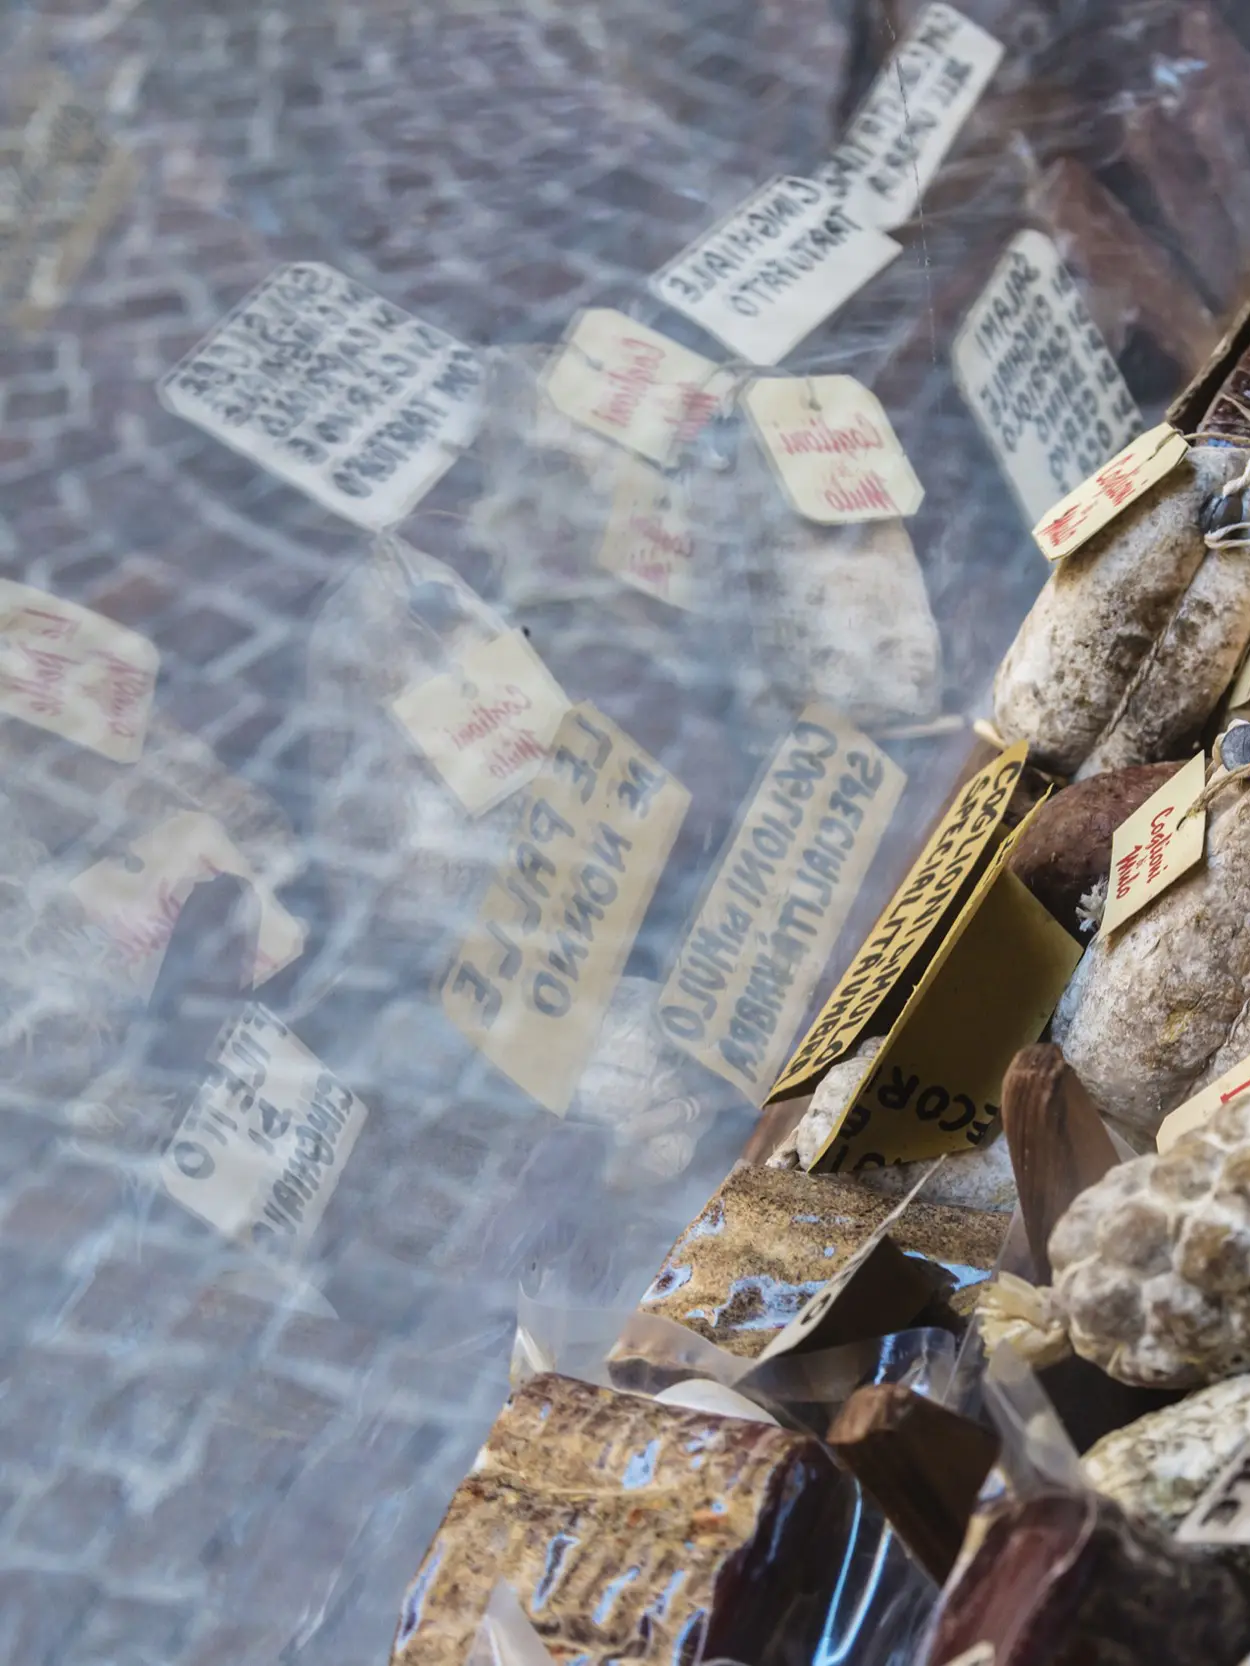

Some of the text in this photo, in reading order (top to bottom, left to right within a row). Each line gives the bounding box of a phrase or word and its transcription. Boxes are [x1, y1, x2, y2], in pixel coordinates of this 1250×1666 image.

[910, 760, 1023, 940] COGLIONI
[1116, 845, 1143, 900] Mulo
[1145, 806, 1175, 884] Coglioni
[813, 966, 901, 1067] MULO
